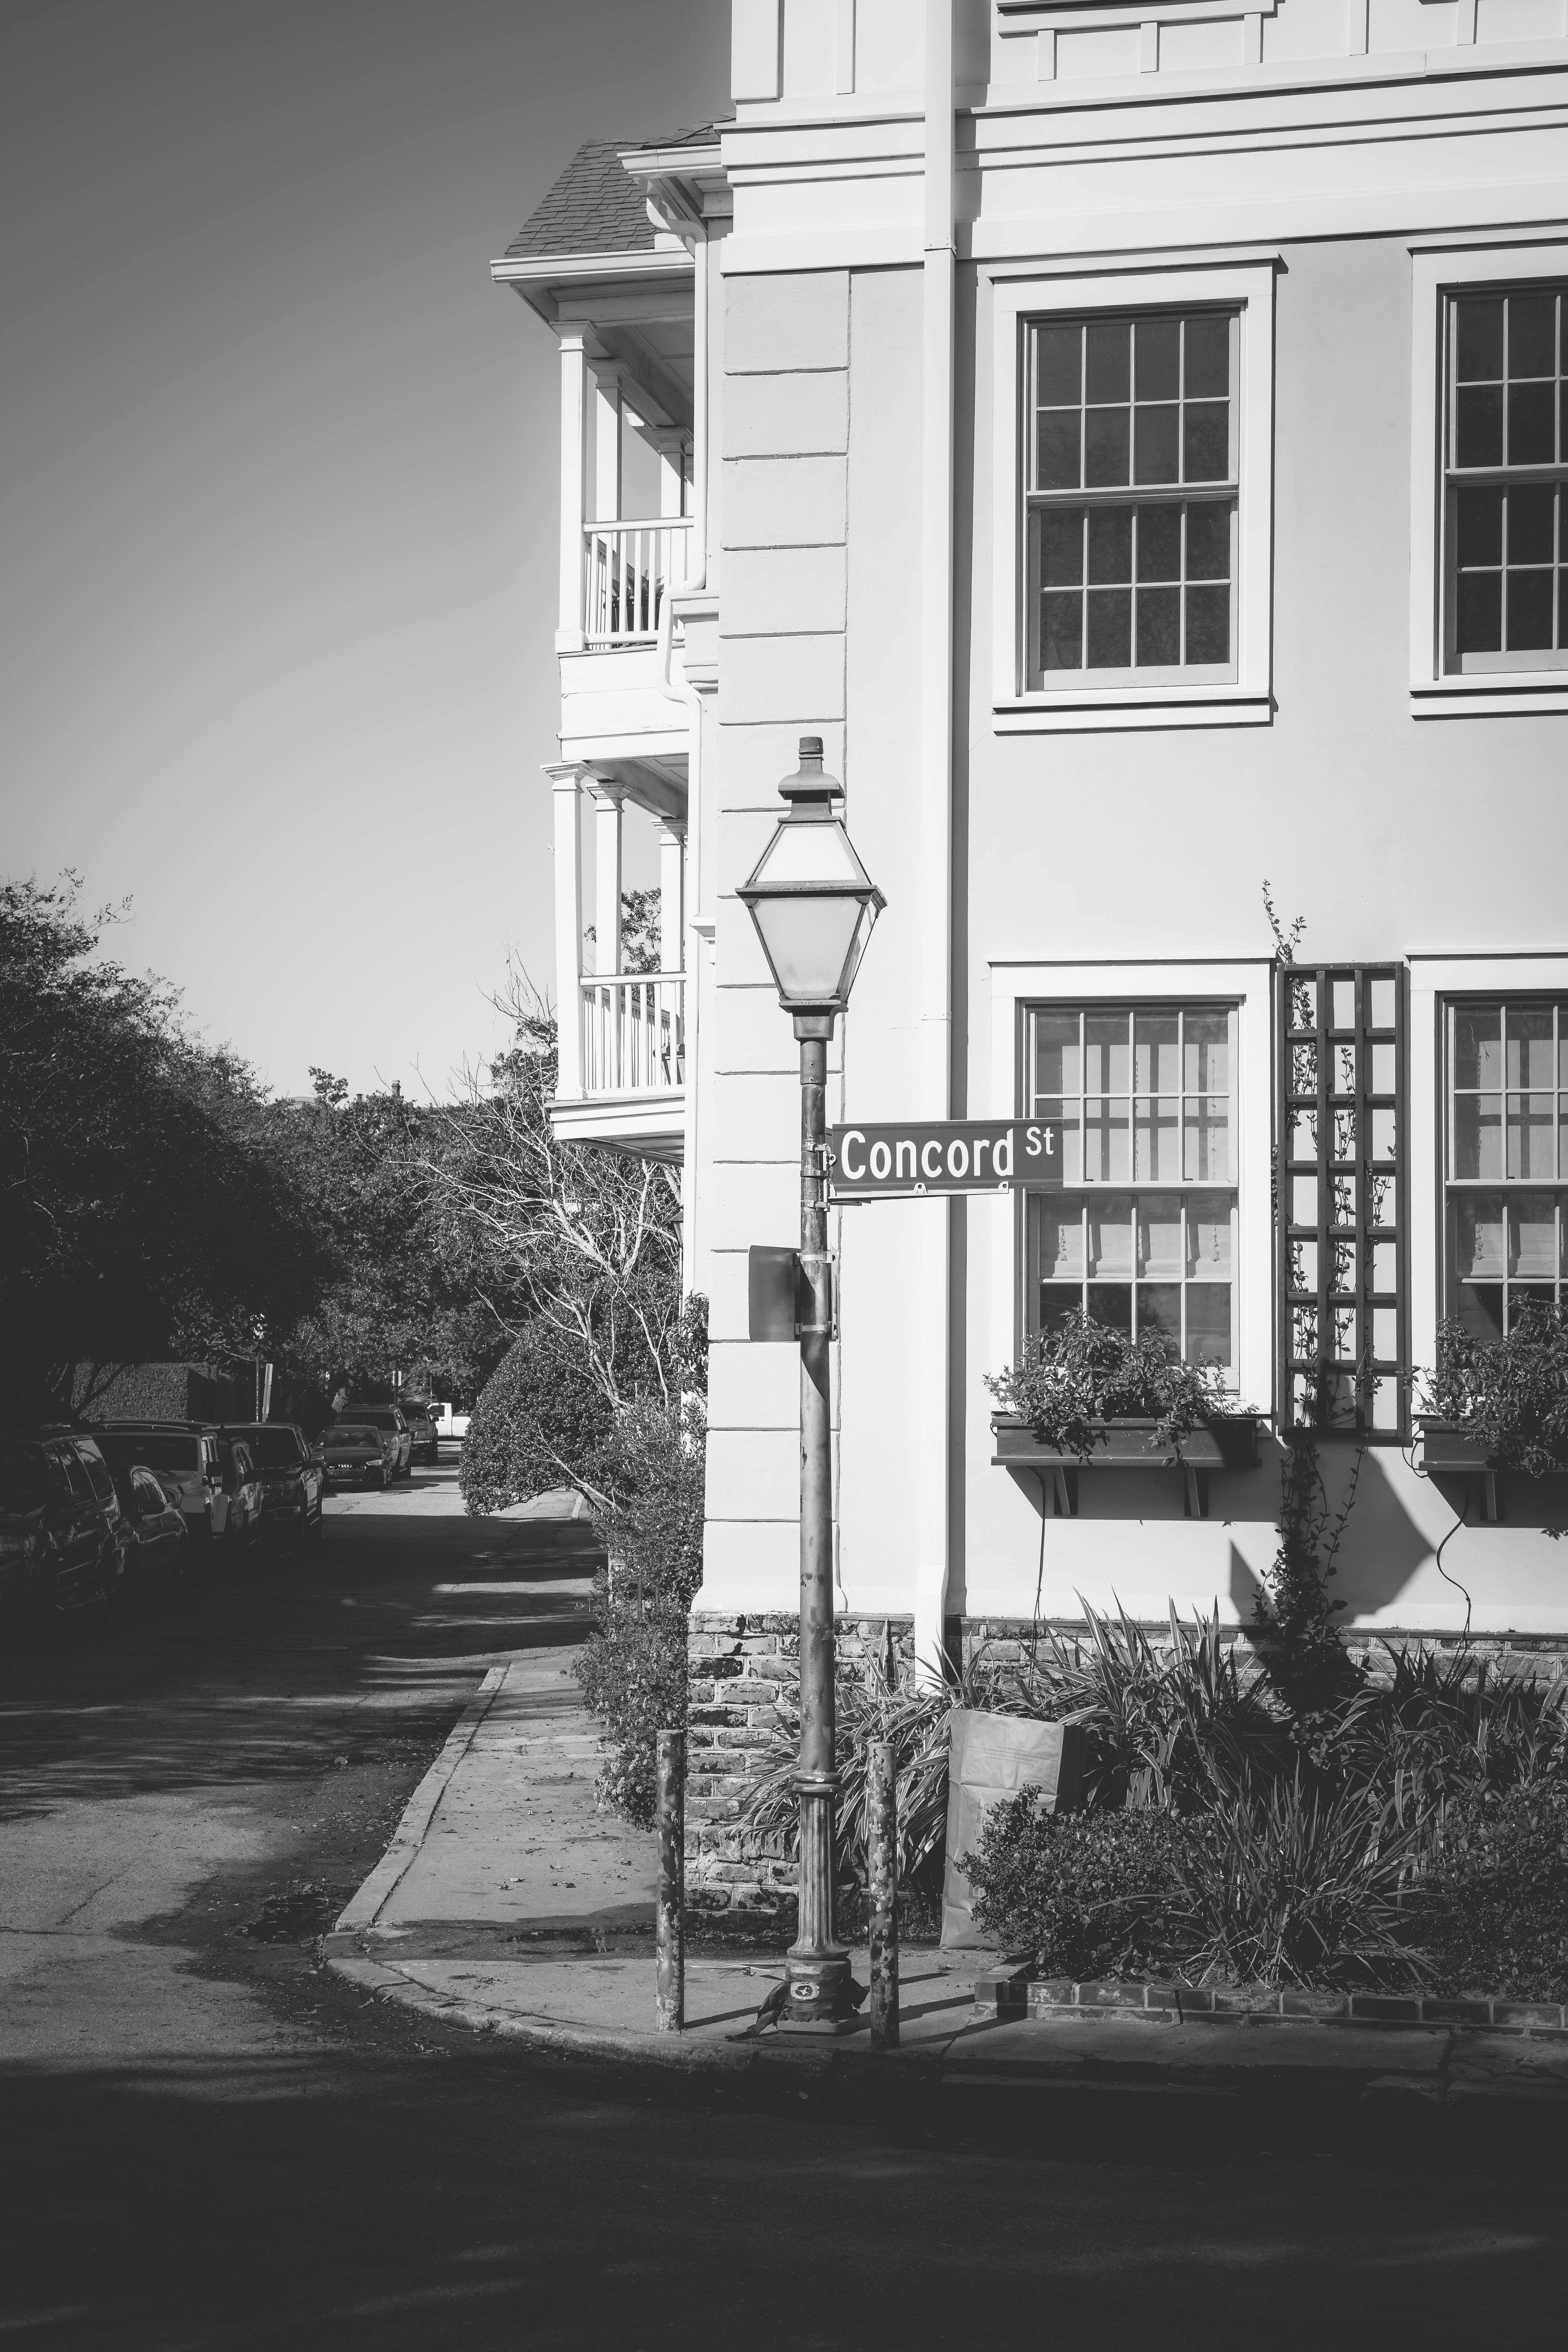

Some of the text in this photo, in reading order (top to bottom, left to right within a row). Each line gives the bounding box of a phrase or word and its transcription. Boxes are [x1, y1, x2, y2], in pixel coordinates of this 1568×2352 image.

[841, 1127, 1054, 1179] Concord St
[978, 1799, 998, 1811] Low
[976, 1813, 995, 1824] kno
